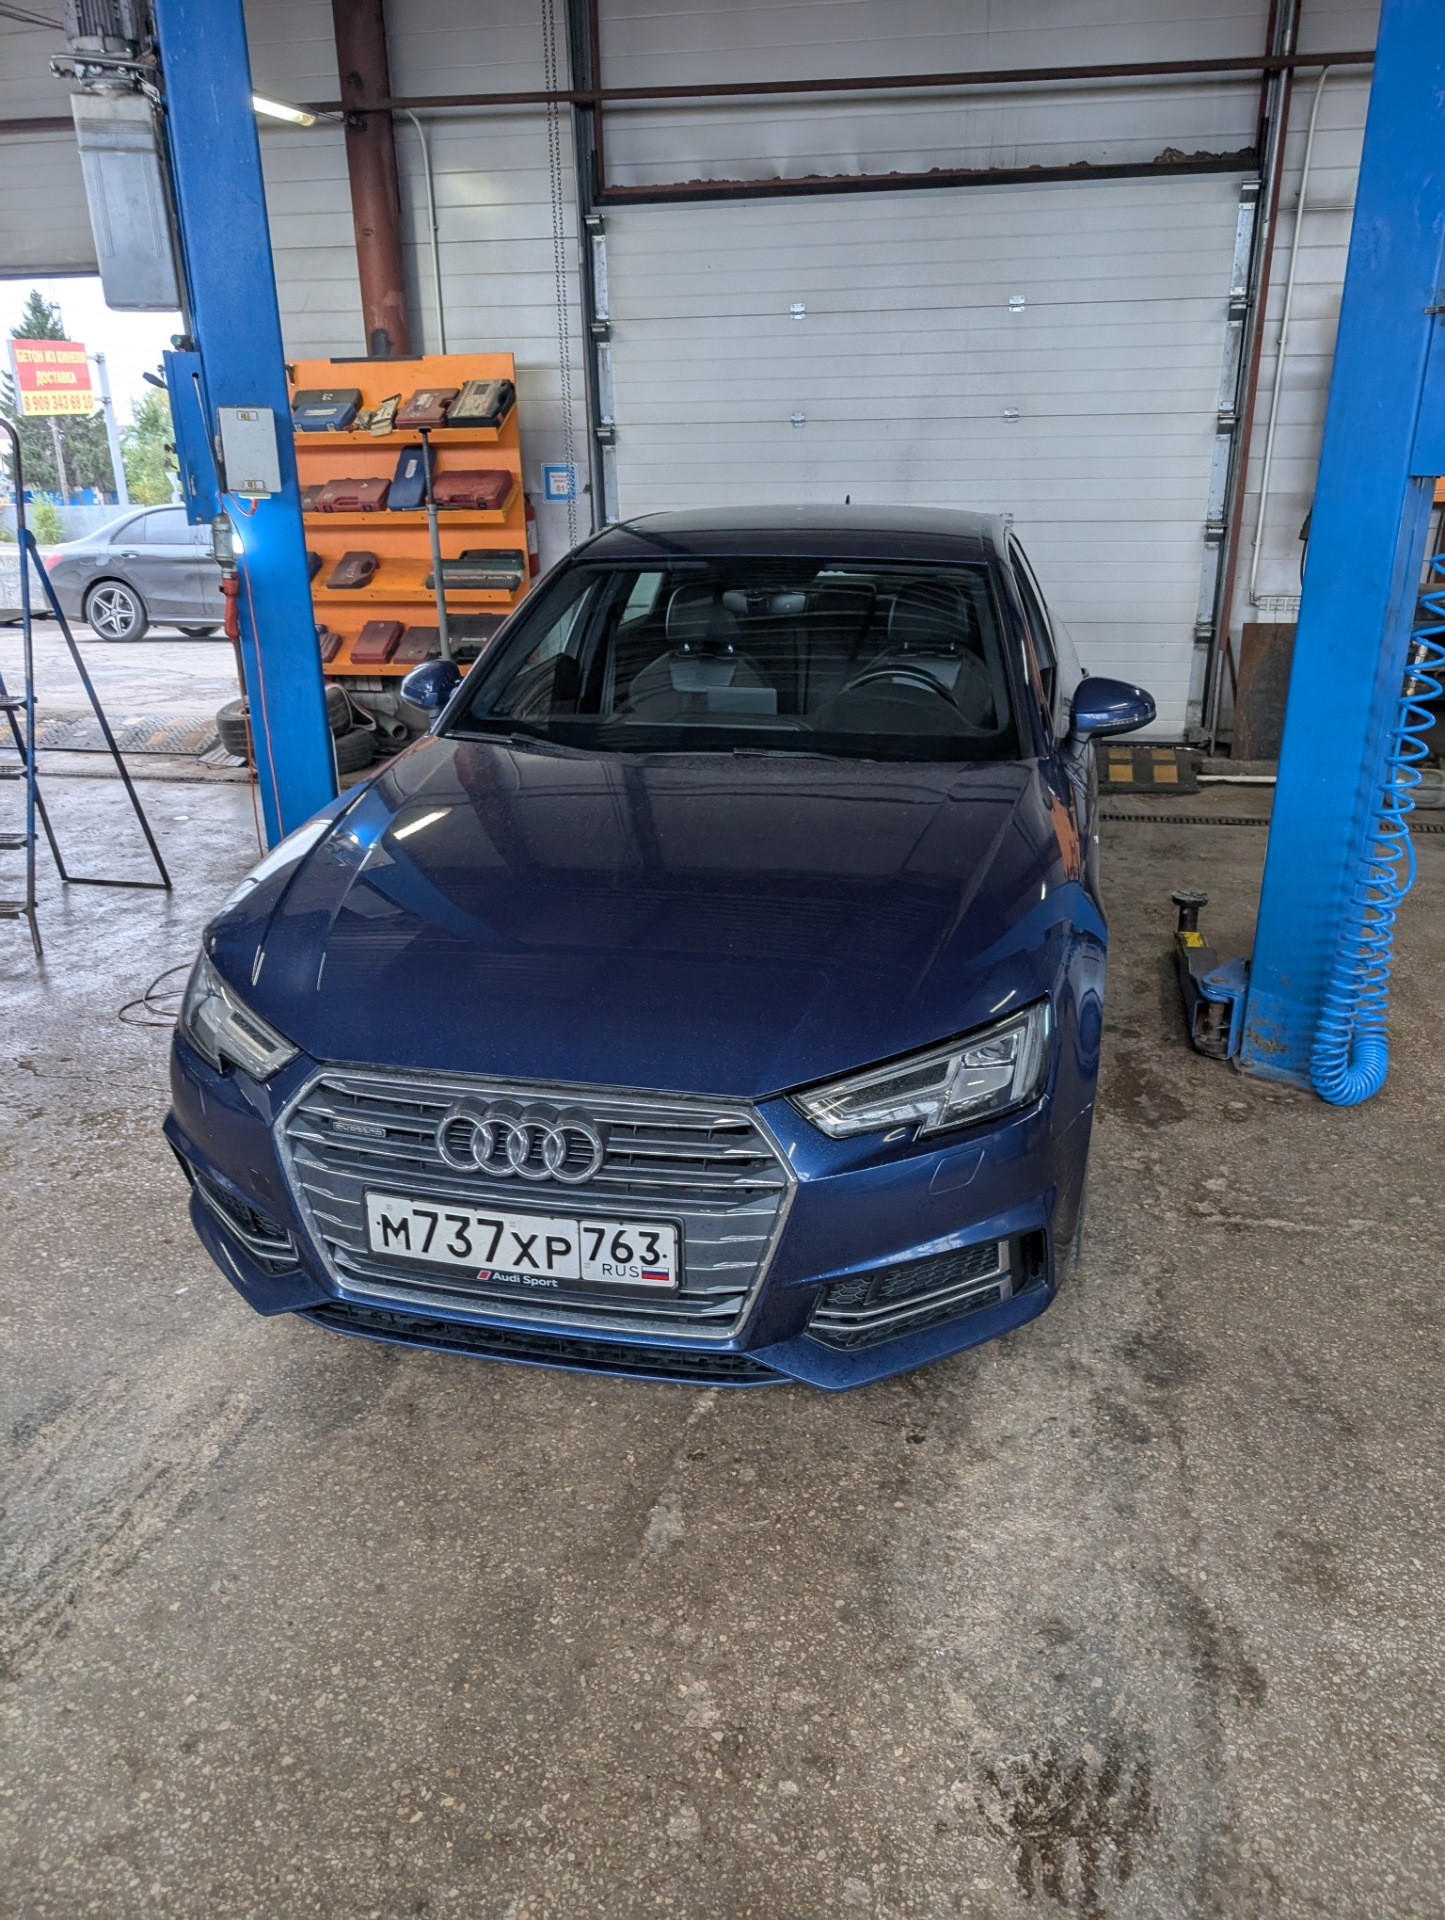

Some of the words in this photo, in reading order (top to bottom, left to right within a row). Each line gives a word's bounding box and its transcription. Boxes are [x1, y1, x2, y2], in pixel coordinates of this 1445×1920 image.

[16, 349, 44, 363] БЕТОН
[36, 371, 77, 386] ДОСТАВКА
[24, 396, 30, 411] 8
[32, 395, 50, 411] 909
[52, 395, 69, 410] 343
[82, 395, 93, 409] 10
[583, 1227, 661, 1266] 763
[601, 1263, 640, 1278] RUS
[492, 1271, 521, 1284] Audi
[523, 1274, 559, 1288] Sport
